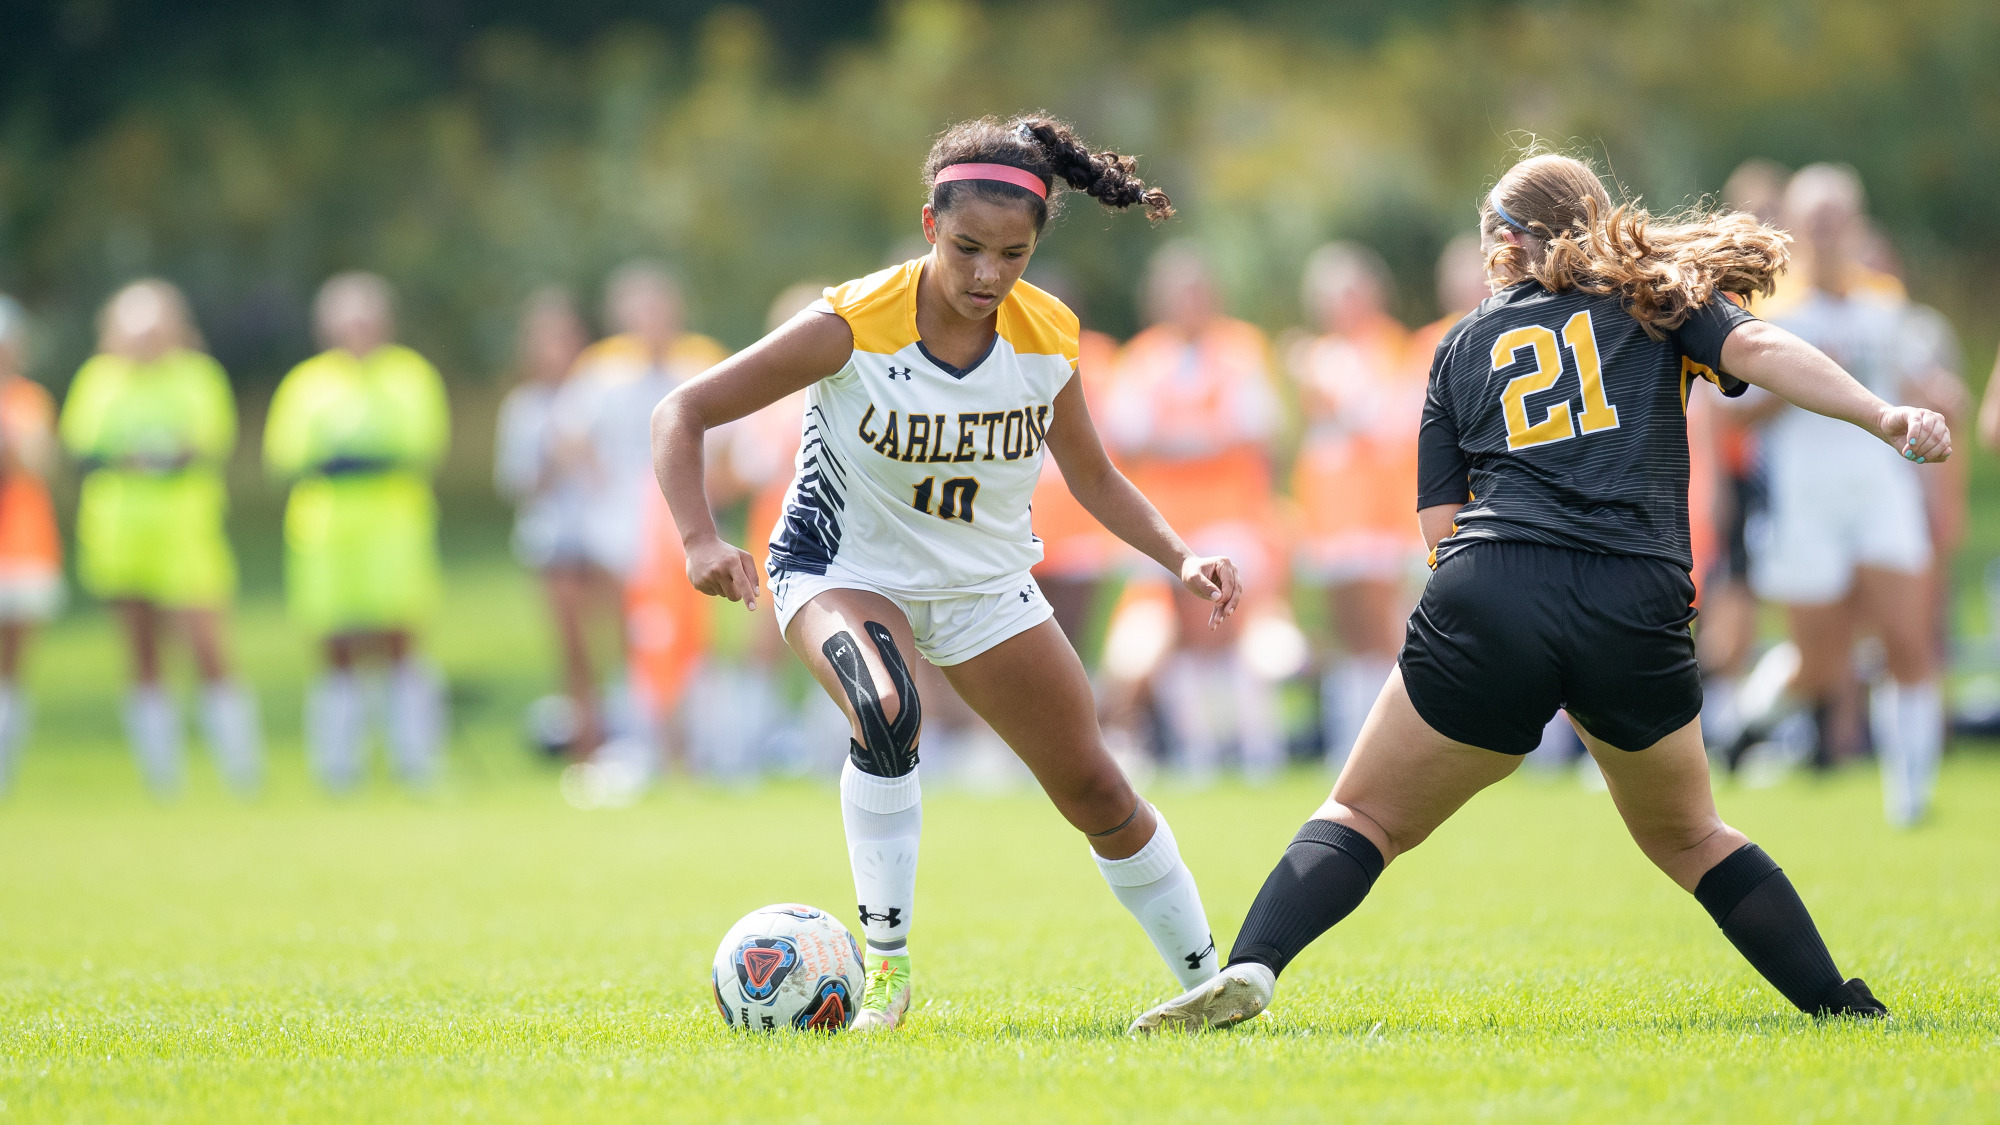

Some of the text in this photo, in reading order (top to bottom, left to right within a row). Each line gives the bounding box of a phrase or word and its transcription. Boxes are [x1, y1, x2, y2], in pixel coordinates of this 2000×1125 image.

[1490, 309, 1621, 452] 21
[858, 402, 1049, 463] CARLETON
[911, 475, 980, 524] 10
[835, 645, 846, 658] KT
